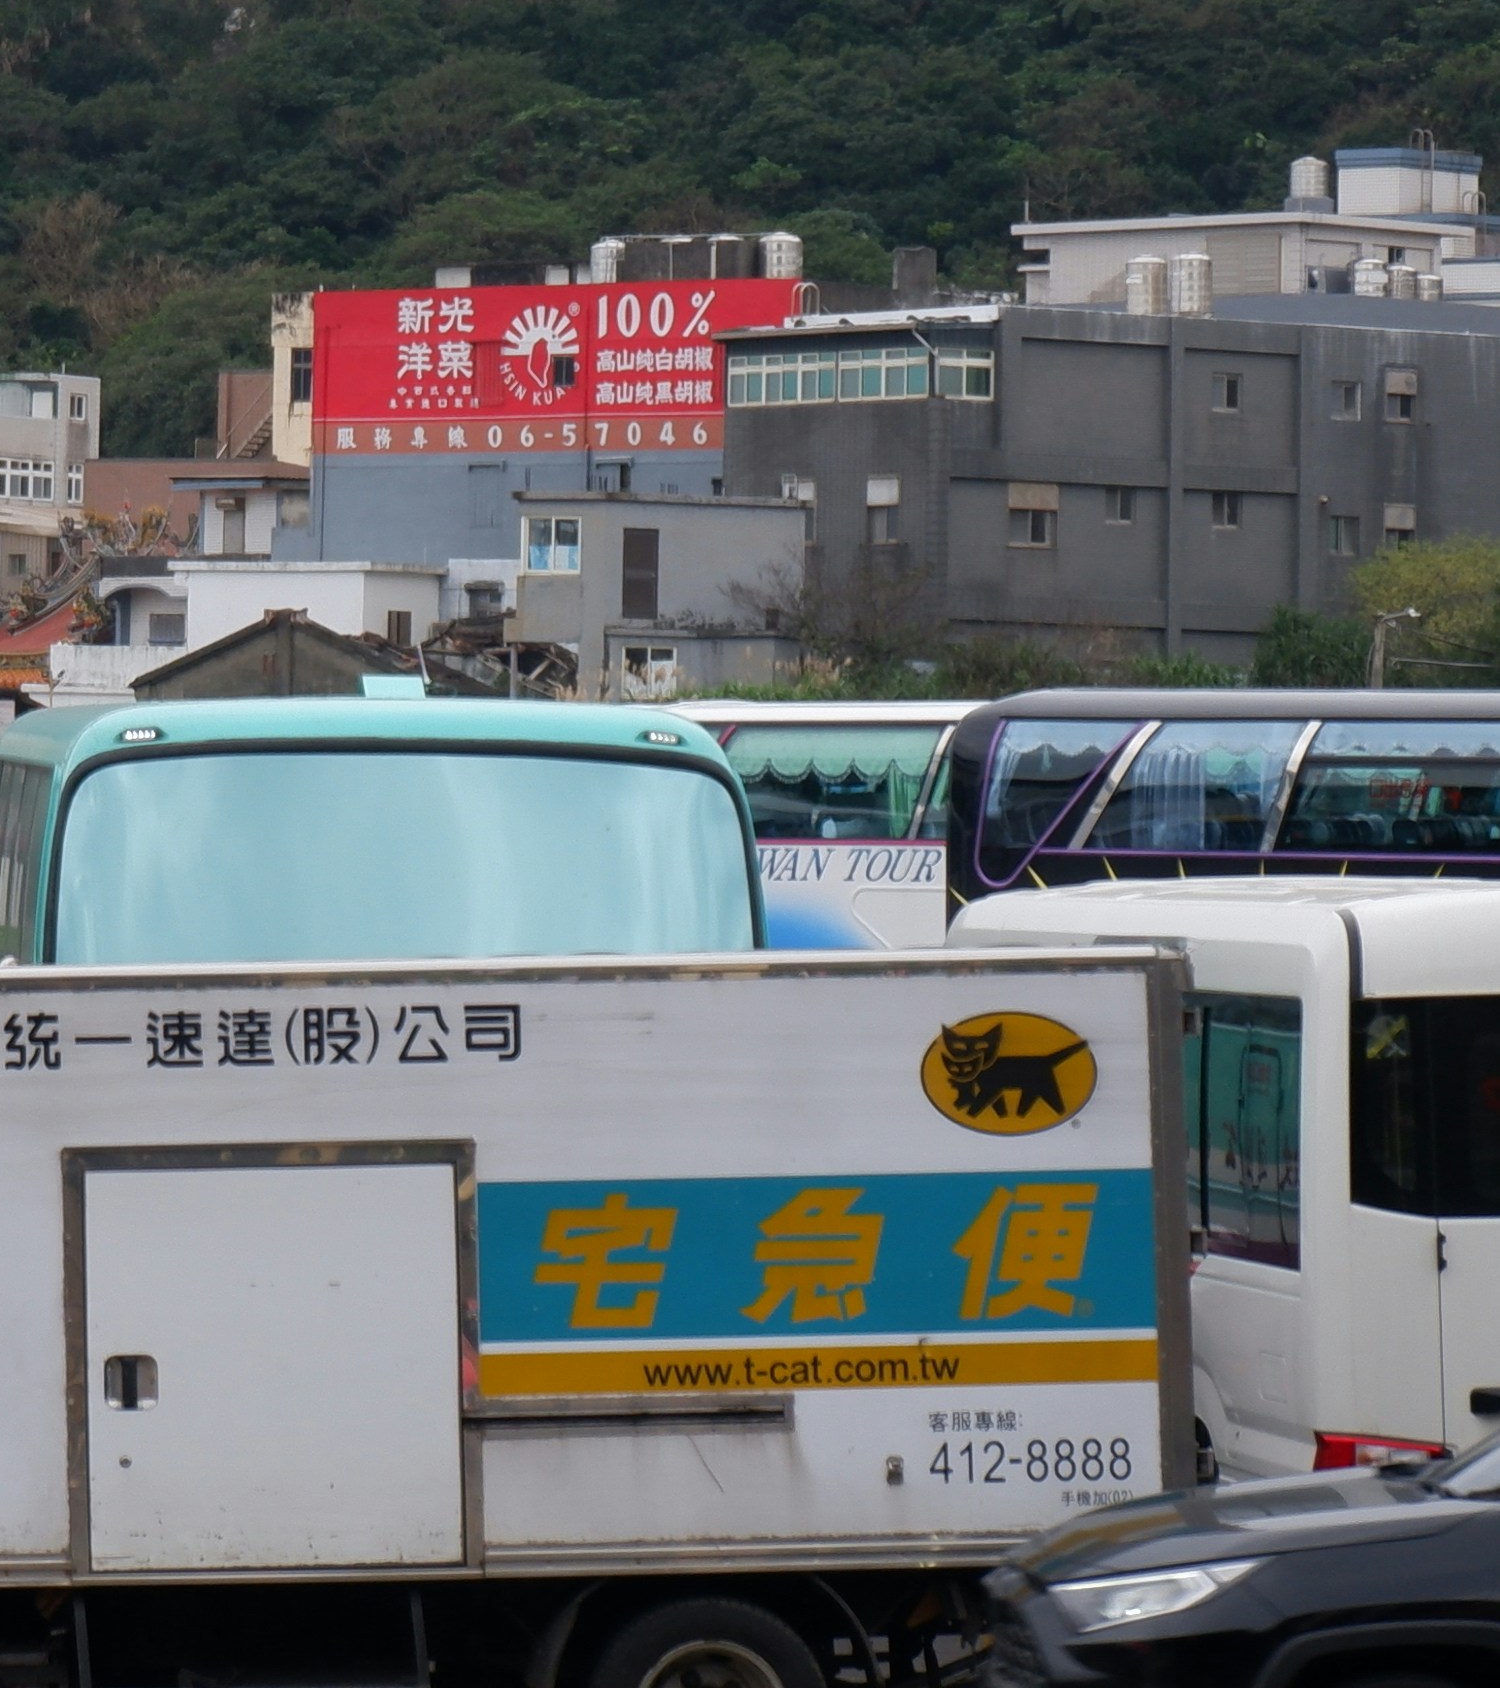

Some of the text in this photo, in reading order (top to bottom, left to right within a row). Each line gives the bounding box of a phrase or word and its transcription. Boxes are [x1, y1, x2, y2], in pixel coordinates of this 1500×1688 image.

[398, 297, 474, 334] 新光
[598, 290, 715, 339] 100%
[397, 340, 473, 380] 洋菜
[500, 361, 527, 401] HSIN
[844, 848, 942, 883] TOUR
[3, 1003, 522, 1070] 統一速達(股)公司
[533, 1181, 1098, 1330] 宅急便
[644, 1352, 960, 1388] www.t-cat.com.tw
[929, 1411, 1023, 1433] 客服專線:
[929, 1438, 1132, 1484] 412-8888
[1061, 1489, 1134, 1507] 手機加(02)
